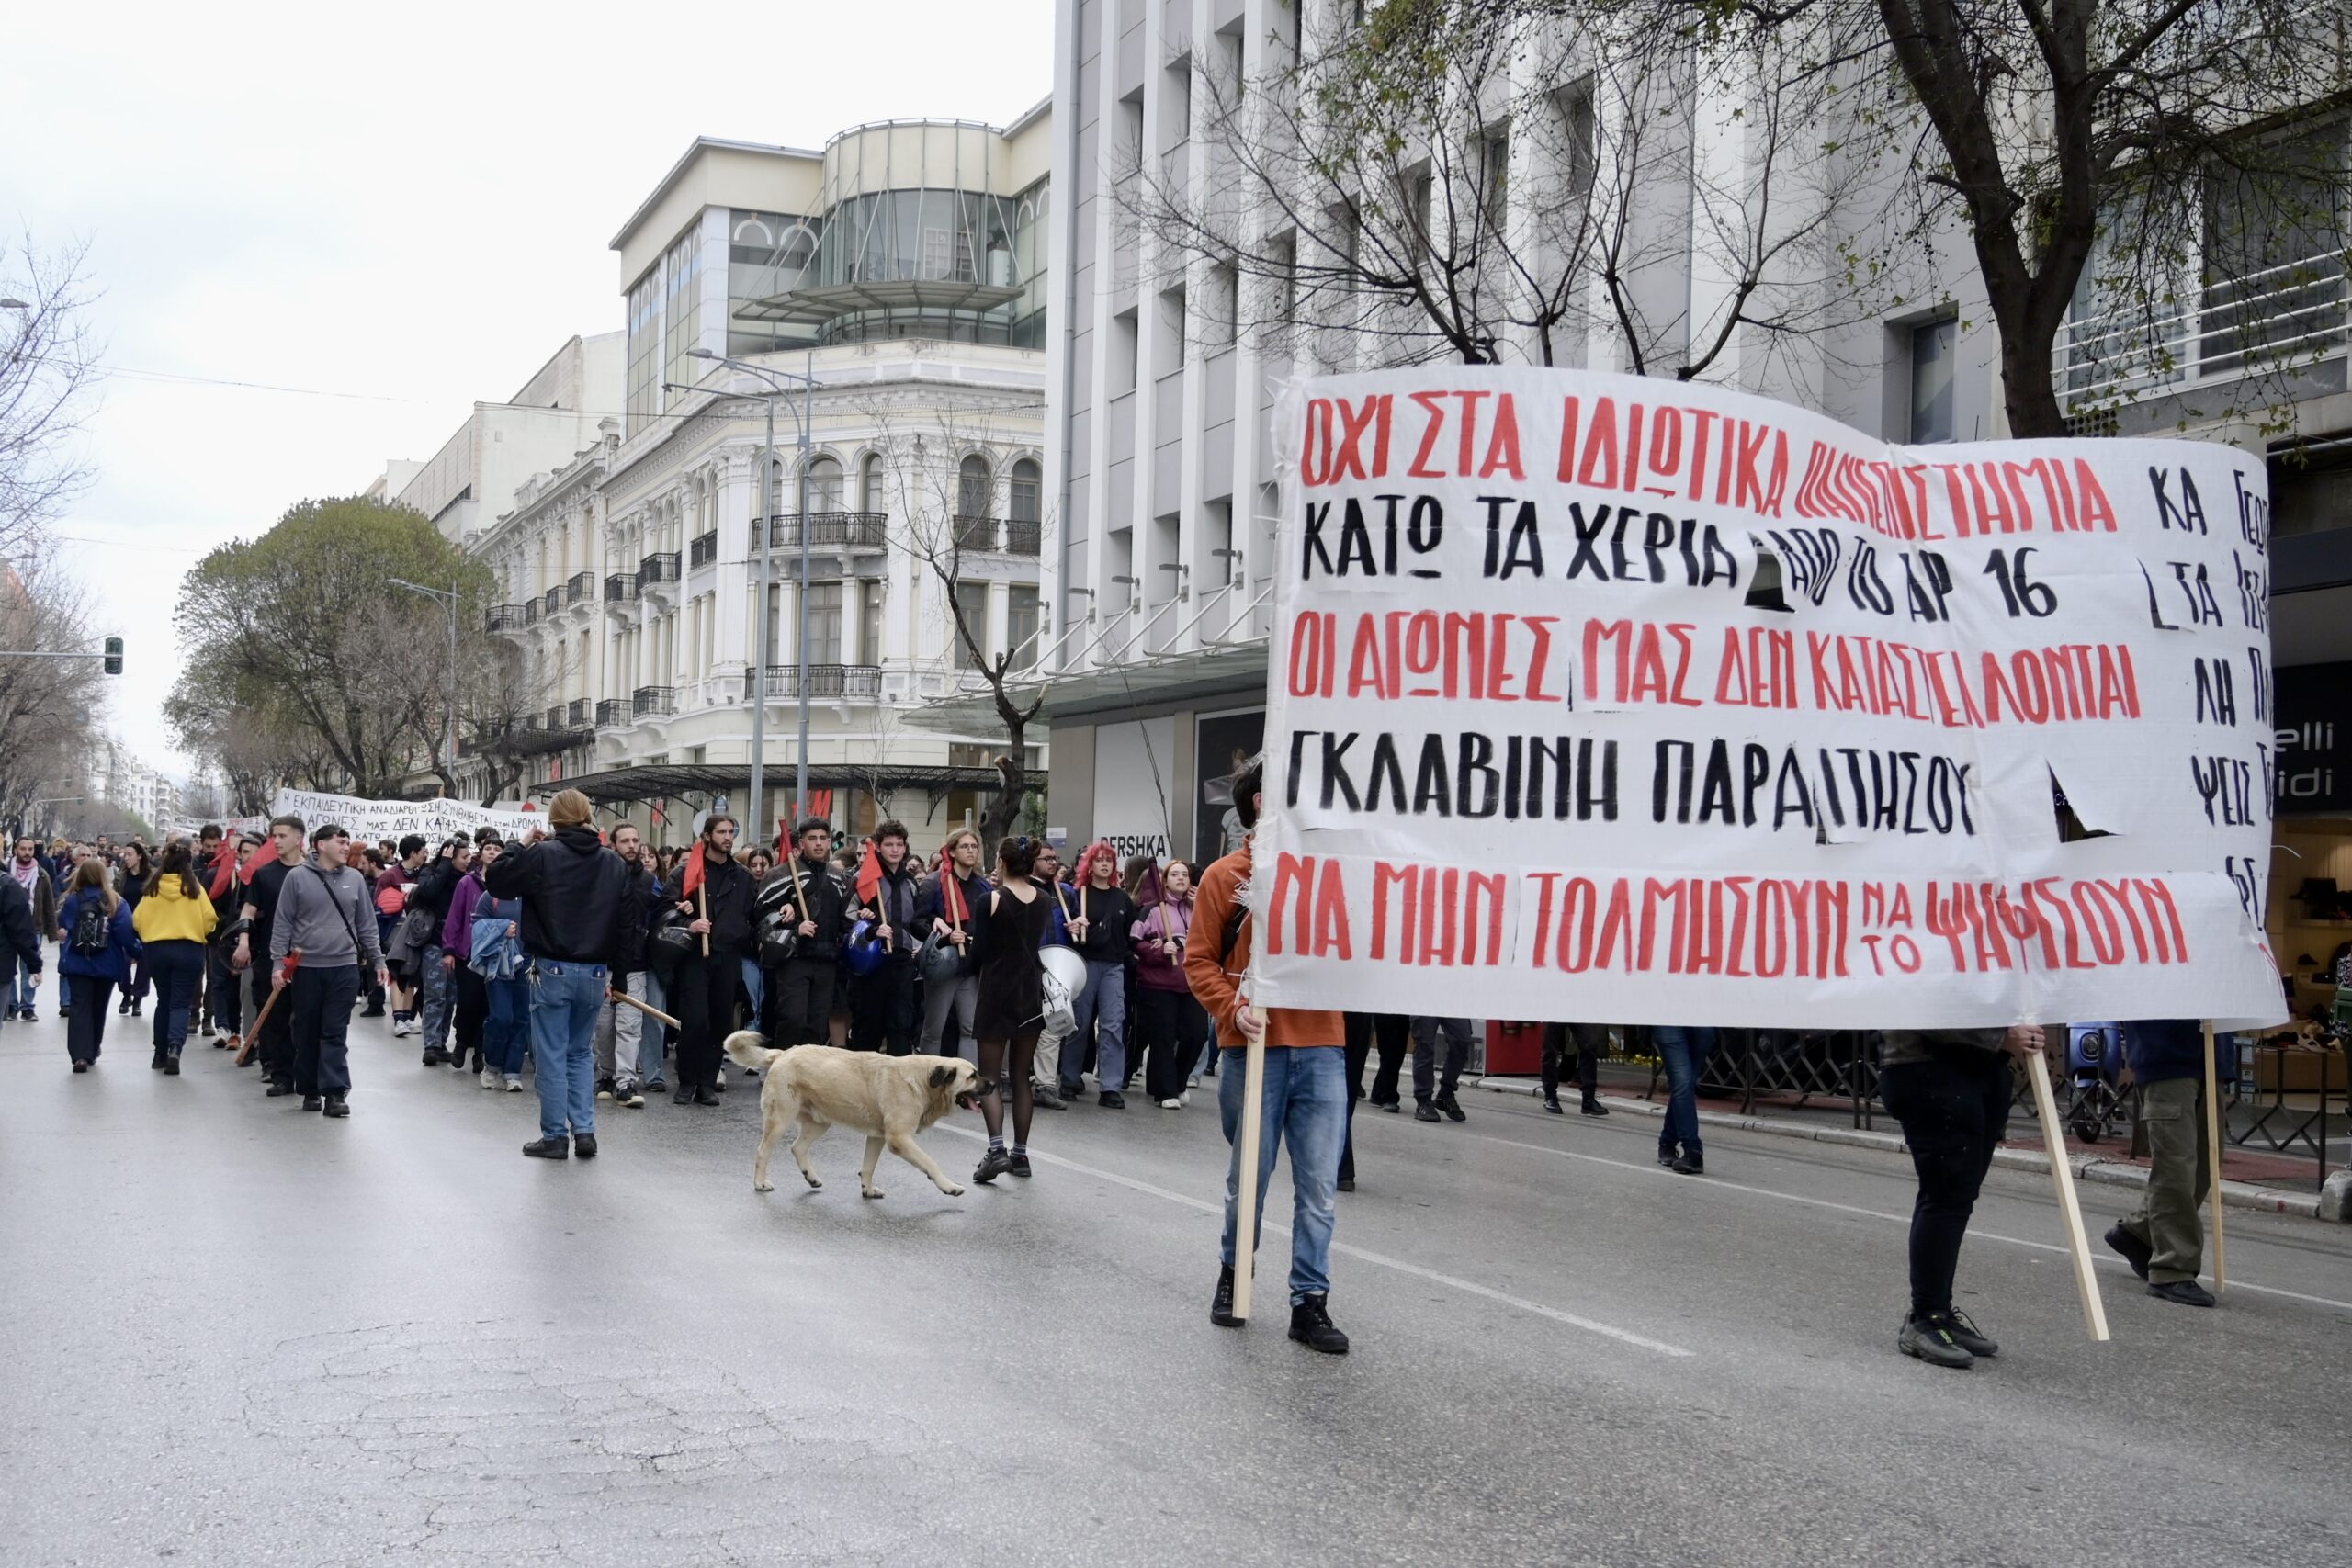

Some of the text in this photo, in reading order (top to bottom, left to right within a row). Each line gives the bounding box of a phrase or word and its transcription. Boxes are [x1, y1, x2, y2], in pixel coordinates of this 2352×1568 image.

[1300, 393, 1394, 487] ΟΧΙ
[1408, 389, 1527, 481] ΣΤΑ
[1556, 395, 1789, 518] ΙΔΙΩΤΙΚΑ
[1303, 494, 1443, 581] ΚΑΤΩ
[1476, 496, 1545, 580] ΤΑ
[1566, 502, 1738, 588] ΧΕΡΙΑ
[1847, 536, 1895, 615] ΤΟ
[1898, 549, 1954, 623] ΑΡ
[1983, 547, 2059, 618] 16
[1288, 610, 1335, 699] ΟΙ
[1347, 609, 1562, 702] ΑΓΩΝΕΣ
[1582, 618, 1702, 707] ΜΑΣ
[1713, 626, 1798, 709] ΔΕΝ
[1287, 731, 1974, 837] ΓΚΛΑΒΙΝΗ ΠΑΡΑΙΤΗΣΟΥ
[2274, 721, 2334, 752] elli
[2278, 768, 2333, 797] idi
[293, 795, 366, 815] ΕΚΠΑΙΔΕΥΤΙΚΗ
[392, 817, 419, 831] ΔΕΝ
[1267, 852, 1352, 961] ΝΑ
[1370, 860, 1506, 966] ΜΗΝ
[1525, 873, 1850, 979] ΤΟΛΜΗΣΟΥΝ
[1862, 881, 1914, 930] ΝΑ
[1926, 876, 2190, 974] ΨΗΦΙΣΟΥΝ
[1860, 935, 1922, 976] ΤΟ
